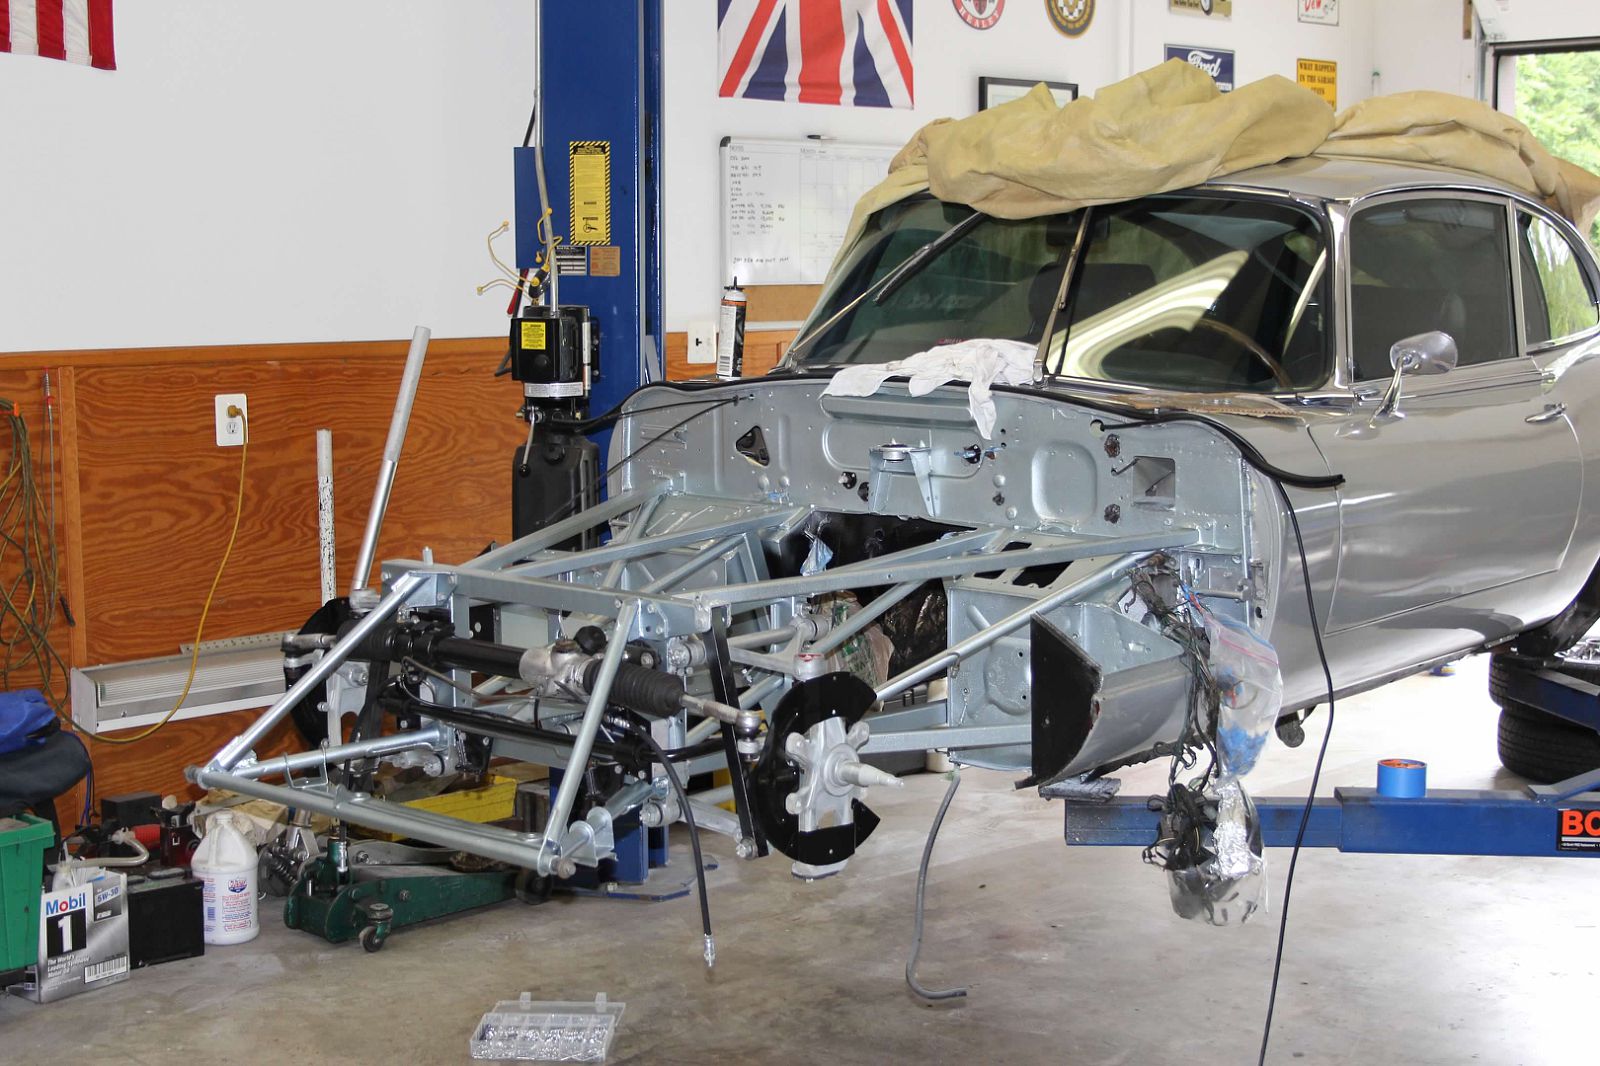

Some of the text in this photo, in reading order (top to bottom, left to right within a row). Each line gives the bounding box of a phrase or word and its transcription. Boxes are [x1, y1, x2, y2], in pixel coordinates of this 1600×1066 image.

[46, 892, 86, 915] Mobil
[97, 887, 119, 903] 5W-30
[57, 915, 73, 953] 1
